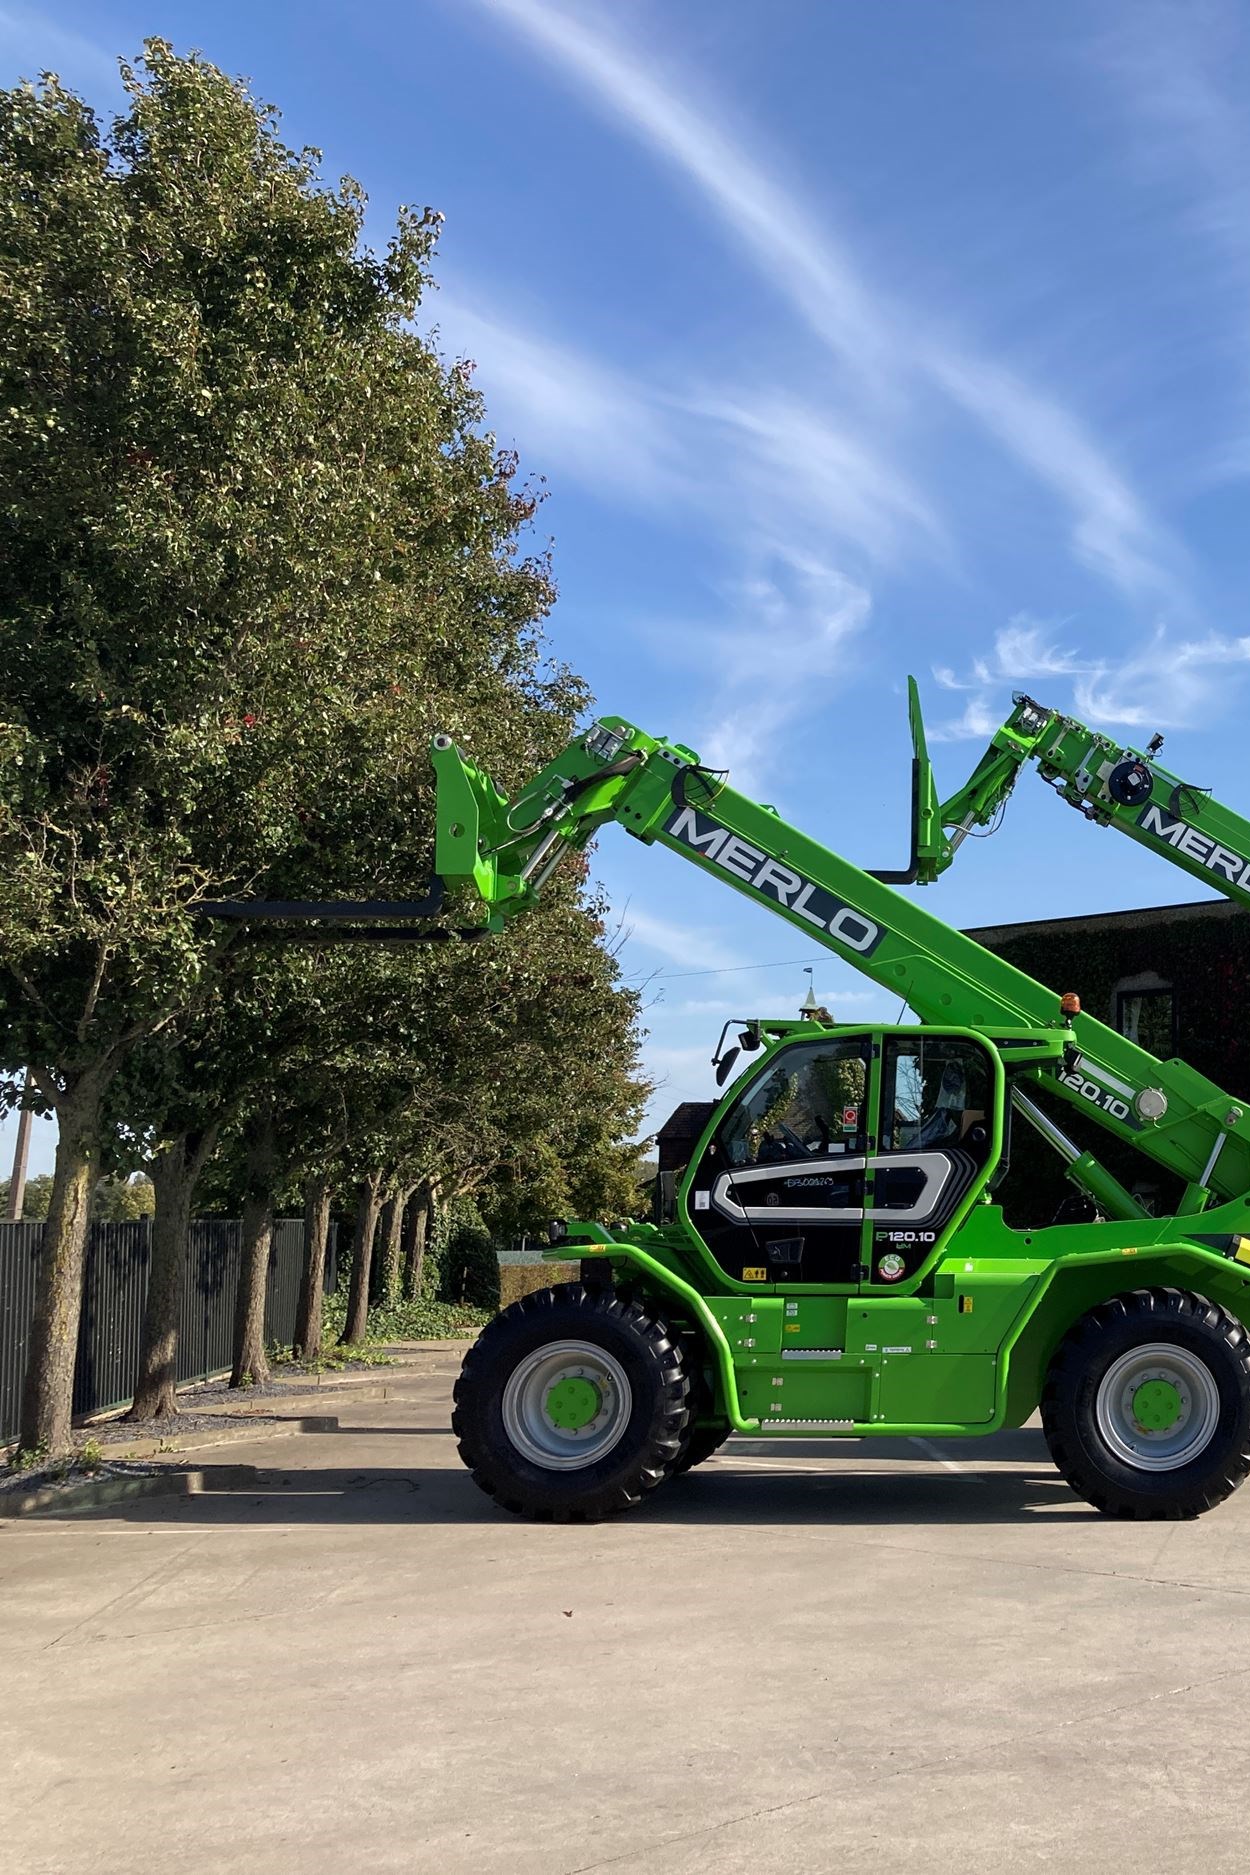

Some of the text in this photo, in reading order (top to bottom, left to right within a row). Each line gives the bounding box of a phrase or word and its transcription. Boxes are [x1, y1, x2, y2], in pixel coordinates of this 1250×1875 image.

[669, 806, 879, 952] MERLO
[1057, 1066, 1130, 1120] 120.10
[876, 1231, 936, 1242] P120.10
